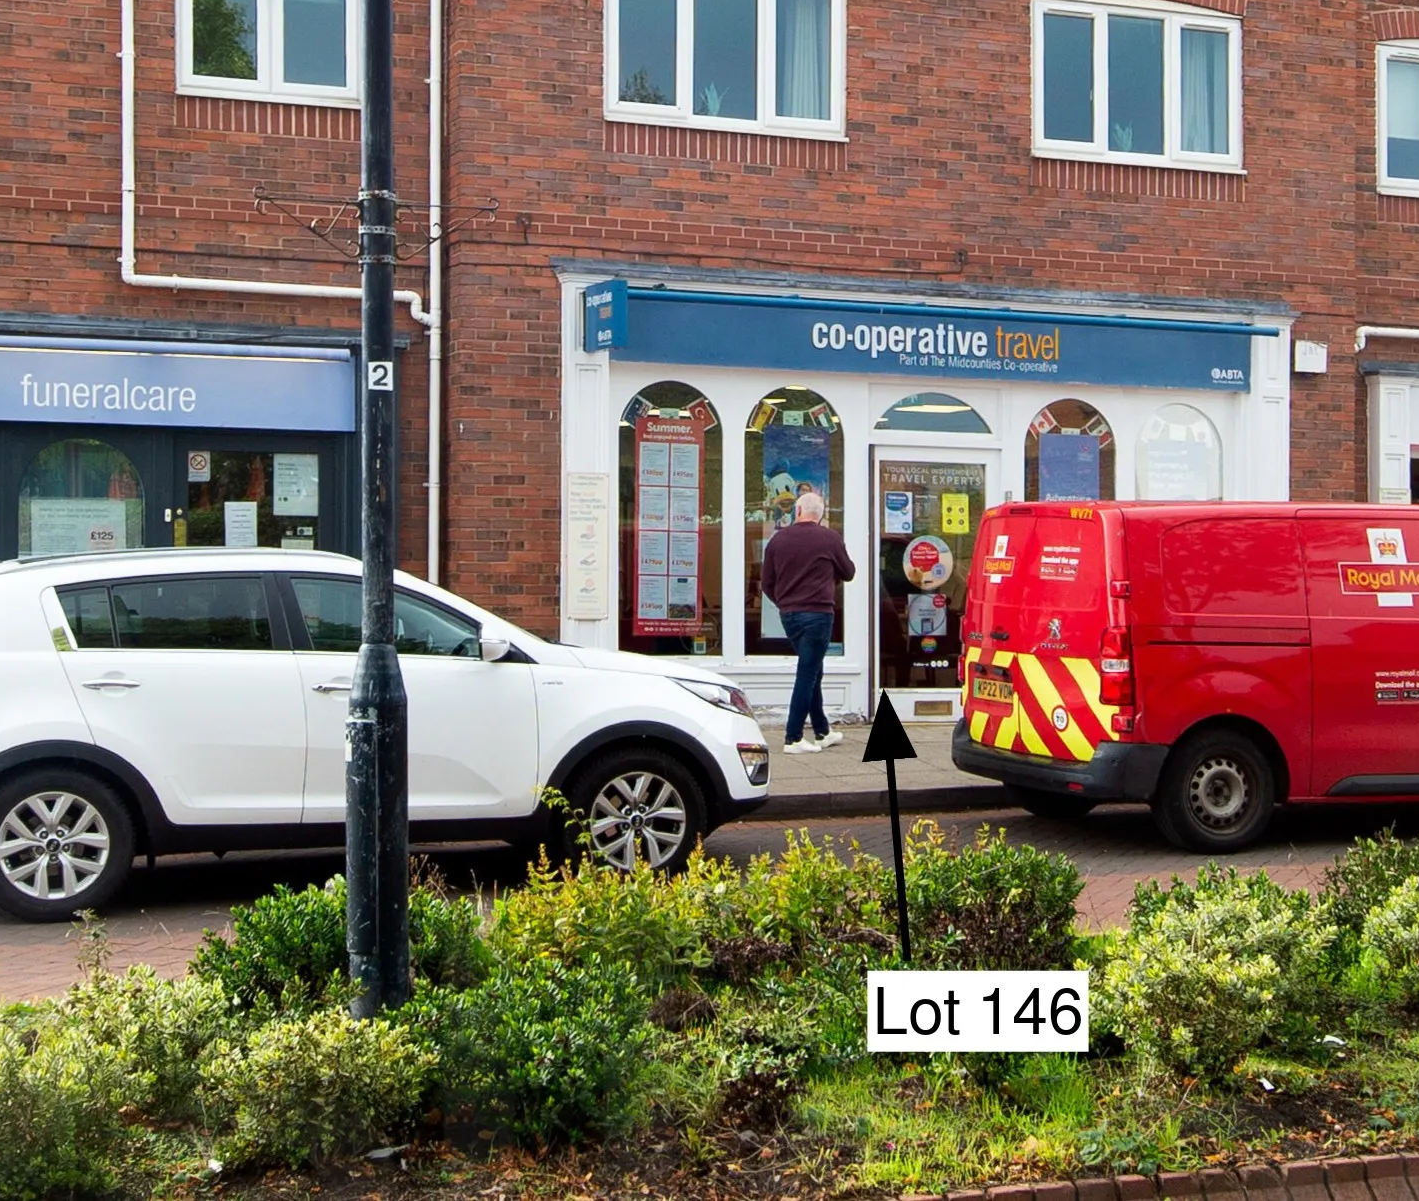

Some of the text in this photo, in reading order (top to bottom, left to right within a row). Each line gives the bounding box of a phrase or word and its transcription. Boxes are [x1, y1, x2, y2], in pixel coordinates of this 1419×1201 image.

[812, 322, 1060, 361] co-operative travel
[899, 354, 1058, 374] Part of The Midcounties Co-operative
[372, 364, 388, 387] 2
[1220, 369, 1244, 380] ABTA
[20, 373, 197, 413] funeralcare
[646, 421, 693, 434] Summer.
[884, 473, 982, 486] TRAVEL EXPERTS
[906, 467, 929, 475] LOCAL
[90, 531, 114, 540] £125
[1347, 568, 1396, 590] Royal
[978, 680, 997, 697] KP22
